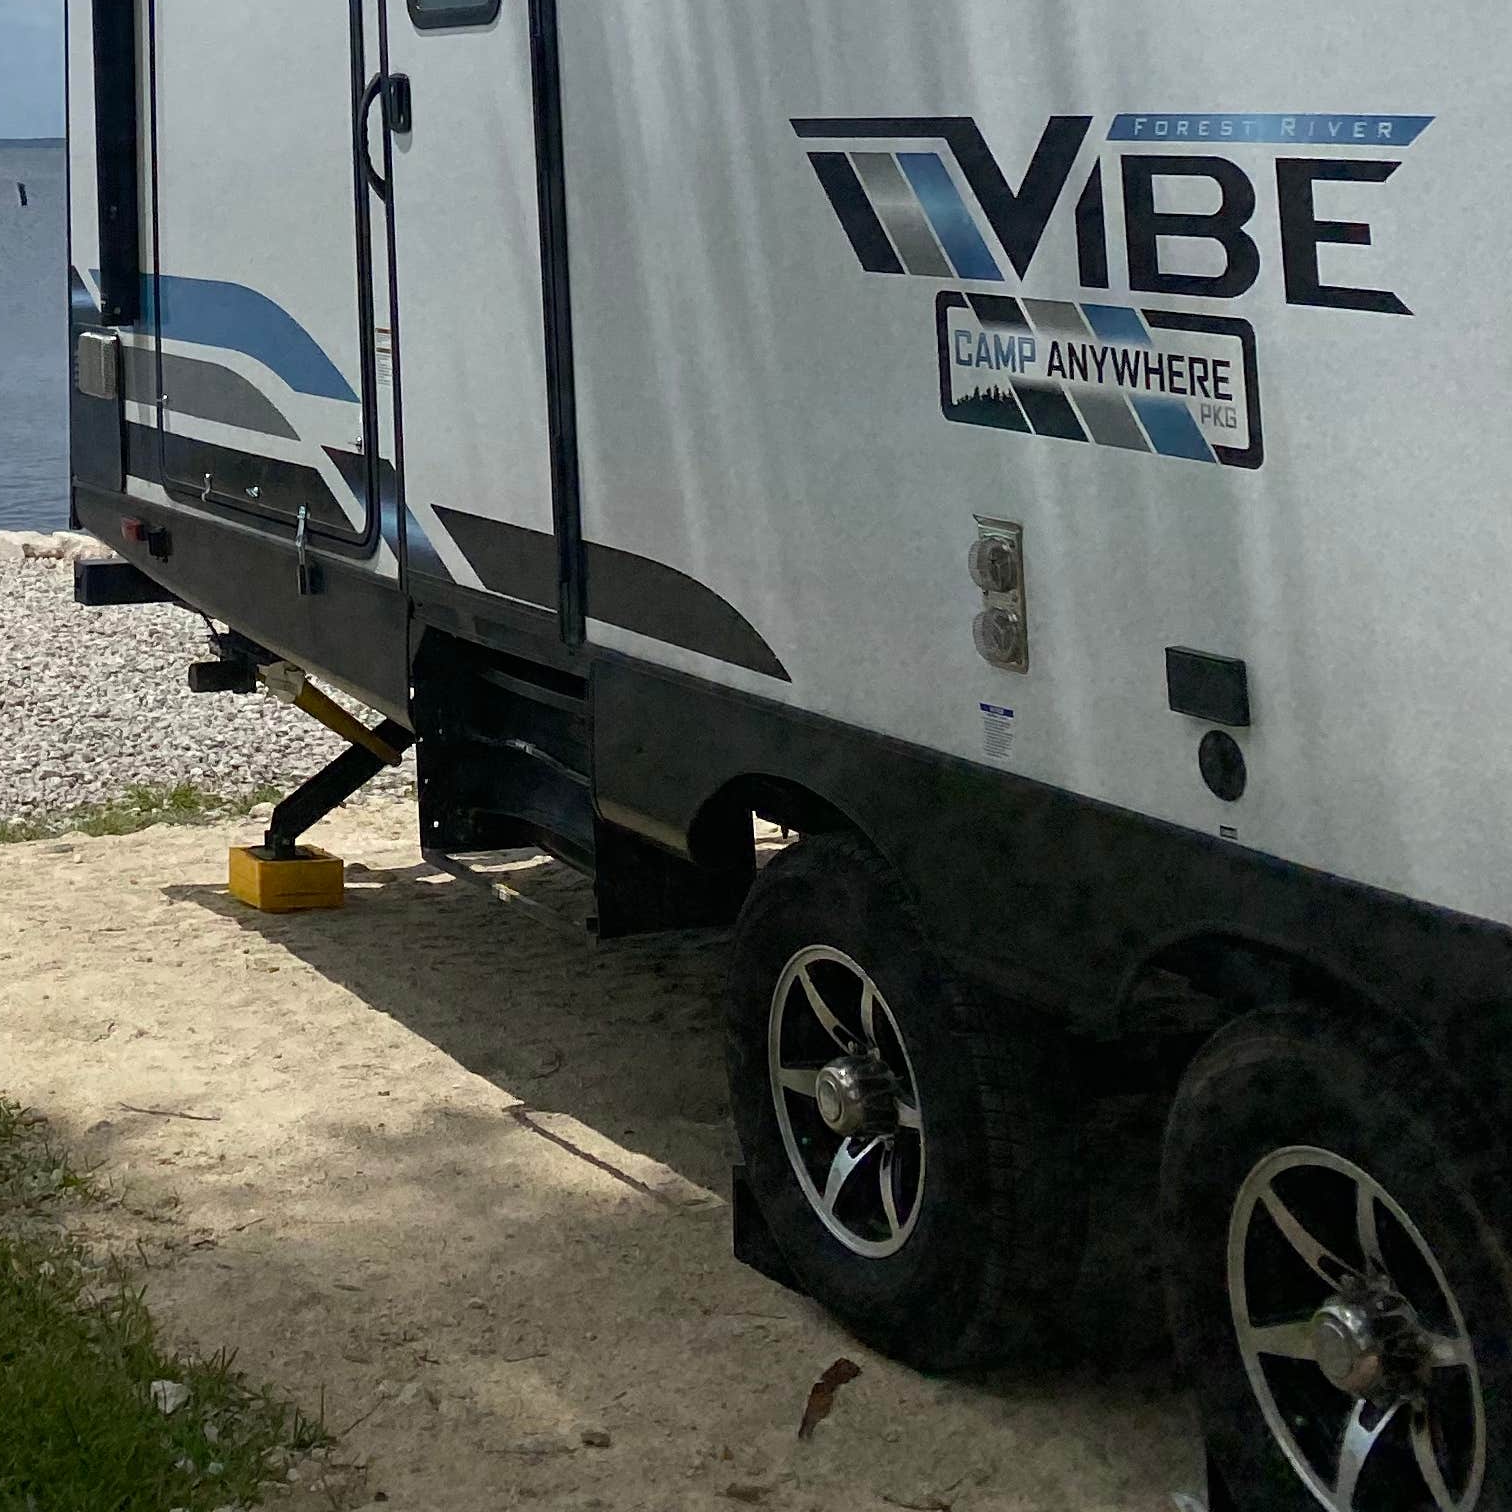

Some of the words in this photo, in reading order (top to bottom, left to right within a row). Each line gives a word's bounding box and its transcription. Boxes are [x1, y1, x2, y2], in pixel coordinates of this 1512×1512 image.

[1134, 117, 1257, 136] FOREST
[1280, 117, 1393, 138] RIVER
[789, 115, 1415, 316] VIBE
[954, 329, 1037, 373] CAMP
[1047, 340, 1233, 401] ANYWHERE
[1200, 404, 1238, 430] PKG
